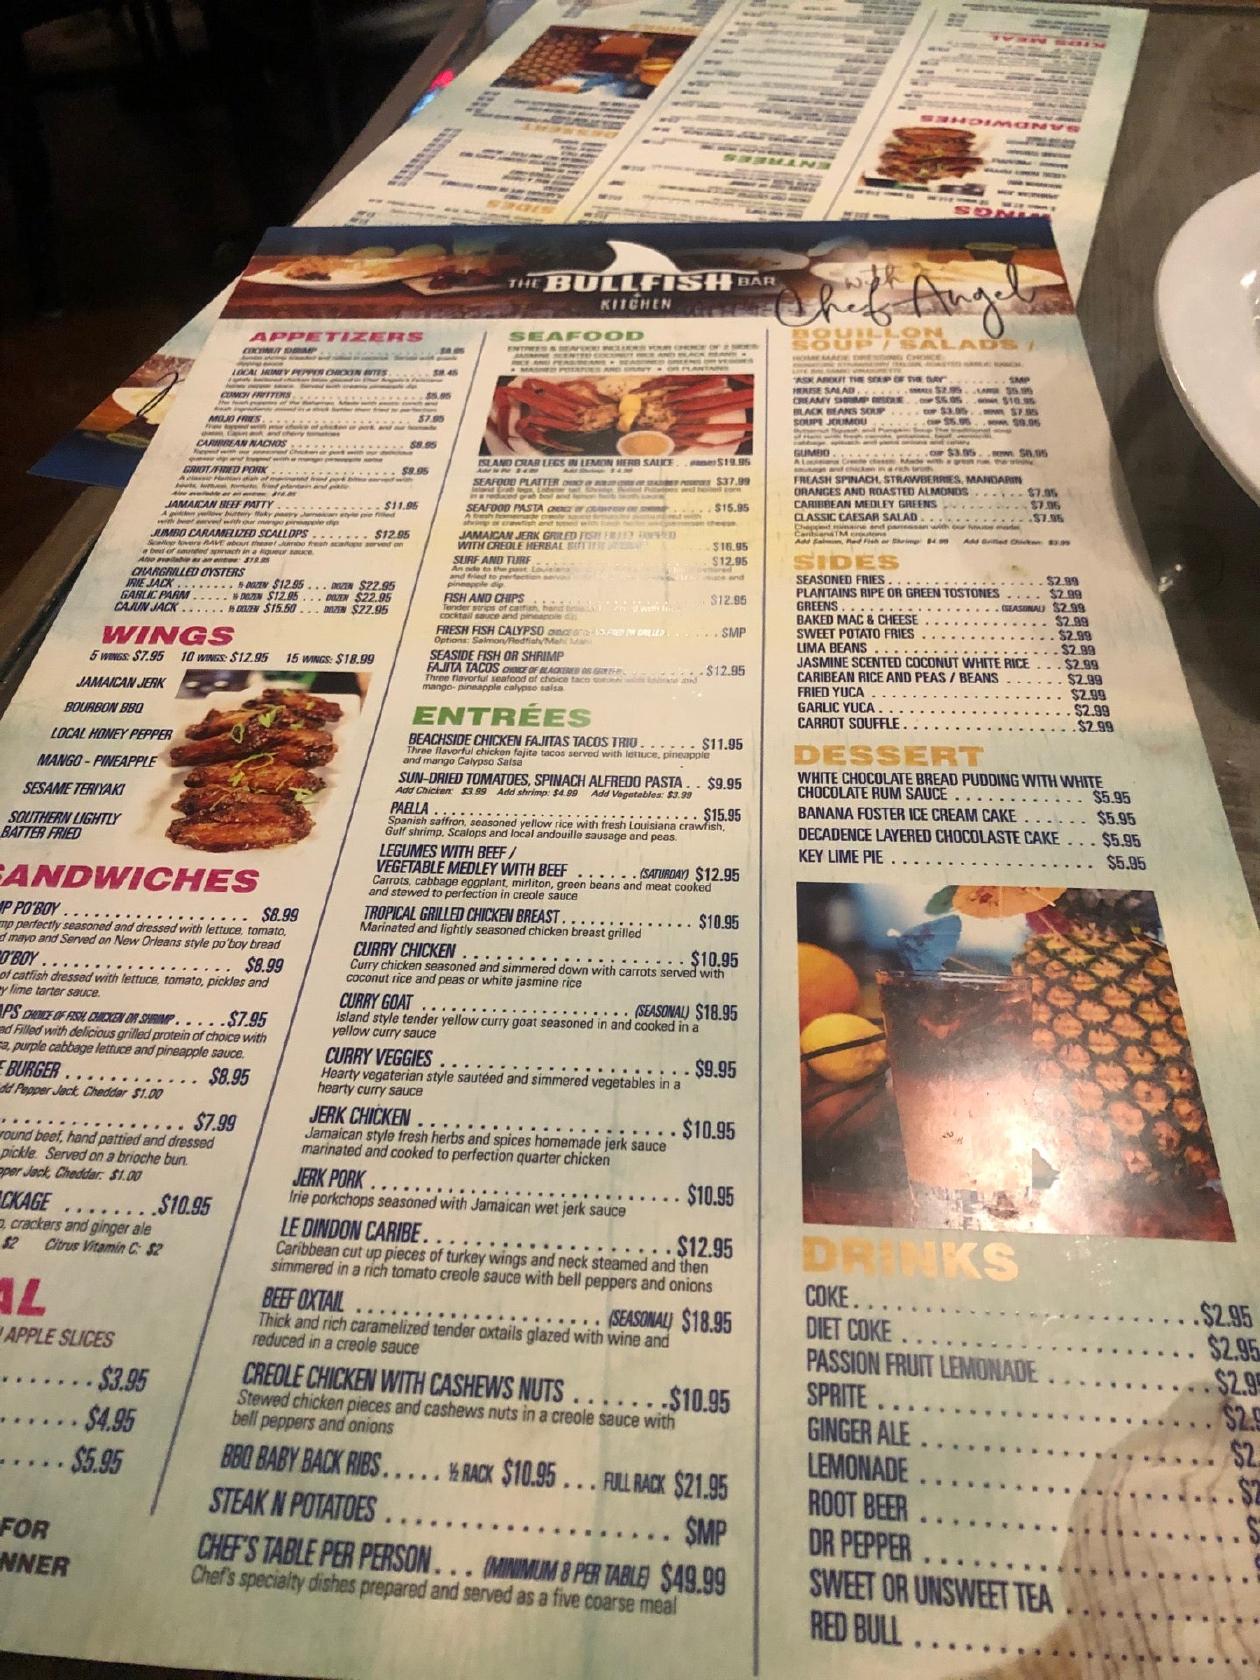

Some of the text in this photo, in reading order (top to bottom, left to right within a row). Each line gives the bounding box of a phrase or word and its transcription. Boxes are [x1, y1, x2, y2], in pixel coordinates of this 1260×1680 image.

[920, 114, 1080, 133] SANDWICHES
[508, 274, 776, 292] THE BULLFISH BAR
[601, 299, 672, 311] KITCHEN
[776, 263, 1036, 339] Chef Angel
[249, 331, 424, 343] APPETIZERS
[509, 331, 645, 341] SEAFOOD
[792, 328, 943, 339] BOUILLON
[792, 340, 872, 351] SOUP
[901, 340, 1018, 350] SALADS
[208, 414, 444, 424] MOJO FRIES $7.95
[793, 408, 824, 416] BLACK
[826, 408, 857, 416] BEANS
[473, 478, 515, 487] SEAFOOD
[518, 478, 559, 486] PLATTER
[165, 500, 419, 510] JAMAICAN BEEF PATTY $11.95
[151, 529, 410, 539] JUMBO CARAMELIZED SCALLOPS $12.95
[793, 555, 900, 570] SIDES
[796, 576, 1079, 586] SEASONED FRIES $2.99
[121, 590, 392, 602] GARLIC PARM $22.95
[444, 594, 525, 603] FISH AND CHIPS
[115, 602, 147, 612] CAJUN
[151, 602, 177, 612] JACK
[352, 604, 389, 615] $22.95
[102, 626, 234, 645] WINGS
[89, 649, 99, 661] 5
[132, 650, 164, 661] $7.95
[181, 652, 194, 662] 10
[230, 652, 269, 663] $12.95
[287, 653, 299, 662] 15
[336, 653, 374, 665] $18.99
[430, 650, 564, 661] SEASIDE FISH OR SHRIMP
[77, 677, 166, 689] JAMAICAN JERK
[64, 702, 144, 713] BOURBON BBQ
[412, 703, 591, 728] ENTRÉES
[798, 718, 1114, 732] CARROT SOUFFLE $2.99
[794, 745, 985, 767] DESSERT
[23, 782, 126, 795] SESAME TERIYAKI
[398, 772, 742, 790] SUN-DRIED TOMATOES, SPINACH ALFREDO PASTA $9.95
[390, 802, 742, 822] PAELLA $15.95
[798, 807, 1136, 825] BANANA FOSTER ICE CREAM CAKE $5.95
[1, 825, 82, 839] BATTER FRIED
[799, 850, 1146, 871] KEY LIME PIE $5.95
[0, 864, 260, 893] ANDWICHES
[262, 907, 299, 922] $8.99
[360, 922, 641, 940] Marinated and lightly seasoned chicken breast grilled
[340, 992, 738, 1021] CURRY GOAT (SEASONAL) $18.95
[5, 1061, 250, 1085] BURGER $8.95
[158, 1196, 212, 1216] $10.95
[10, 1218, 152, 1235] crackers and ginger ale
[280, 1217, 733, 1260] LE DINDON CARIBE $12.95
[802, 1236, 1019, 1281] DRINKS
[805, 1285, 1252, 1328] COKE $2.95
[4, 1327, 115, 1348] APPLE SLICES
[807, 1349, 1038, 1383] PASSION FRUIT LEMONADE
[98, 1364, 149, 1392] $3.95
[242, 1362, 730, 1414] CREOLE CHICKEN WITH CASHEWS NUTS $10.95
[807, 1383, 867, 1409] SPRITE
[808, 1417, 910, 1446] GINGER ALE
[209, 1488, 376, 1523] STEAK N POTATOES
[809, 1489, 908, 1521] ROOT BEER
[0, 1516, 50, 1540] FOR
[809, 1569, 1054, 1614] SWEET OR UNSWEET TEA
[811, 1610, 902, 1646] RED BULL
